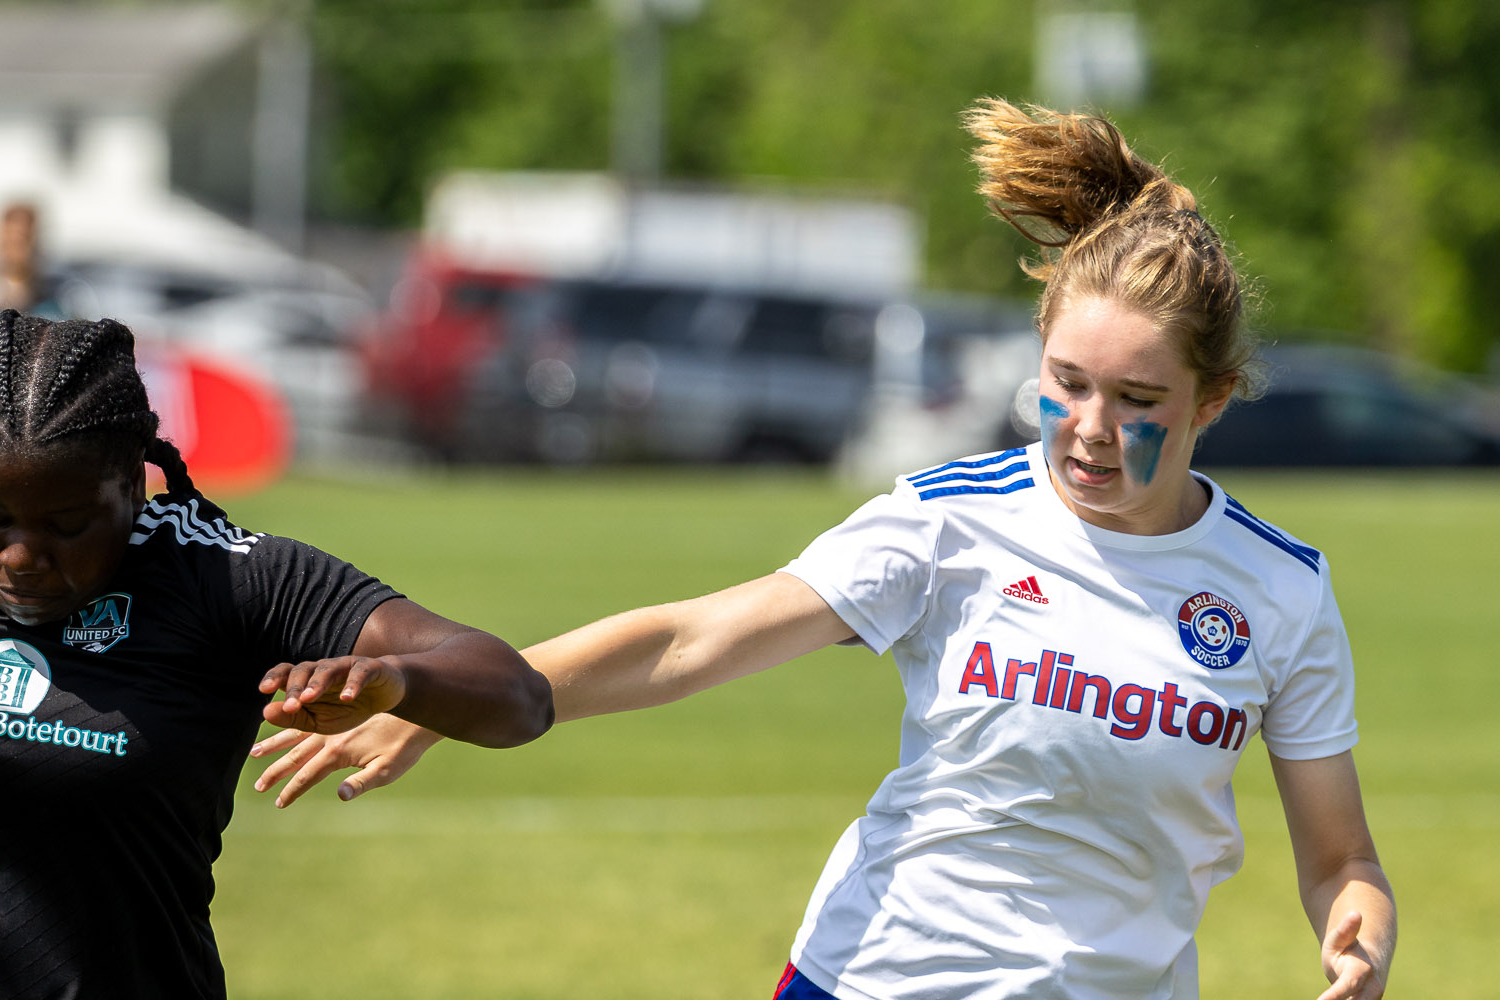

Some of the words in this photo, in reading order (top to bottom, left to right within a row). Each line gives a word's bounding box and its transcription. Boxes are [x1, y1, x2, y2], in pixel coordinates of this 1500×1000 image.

[1003, 586, 1049, 605] adidas
[1187, 594, 1244, 624] ARLINGTON
[66, 629, 109, 641] UNITED
[112, 625, 126, 637] FC
[1191, 645, 1231, 667] SOCCER
[958, 640, 1248, 751] Arlington
